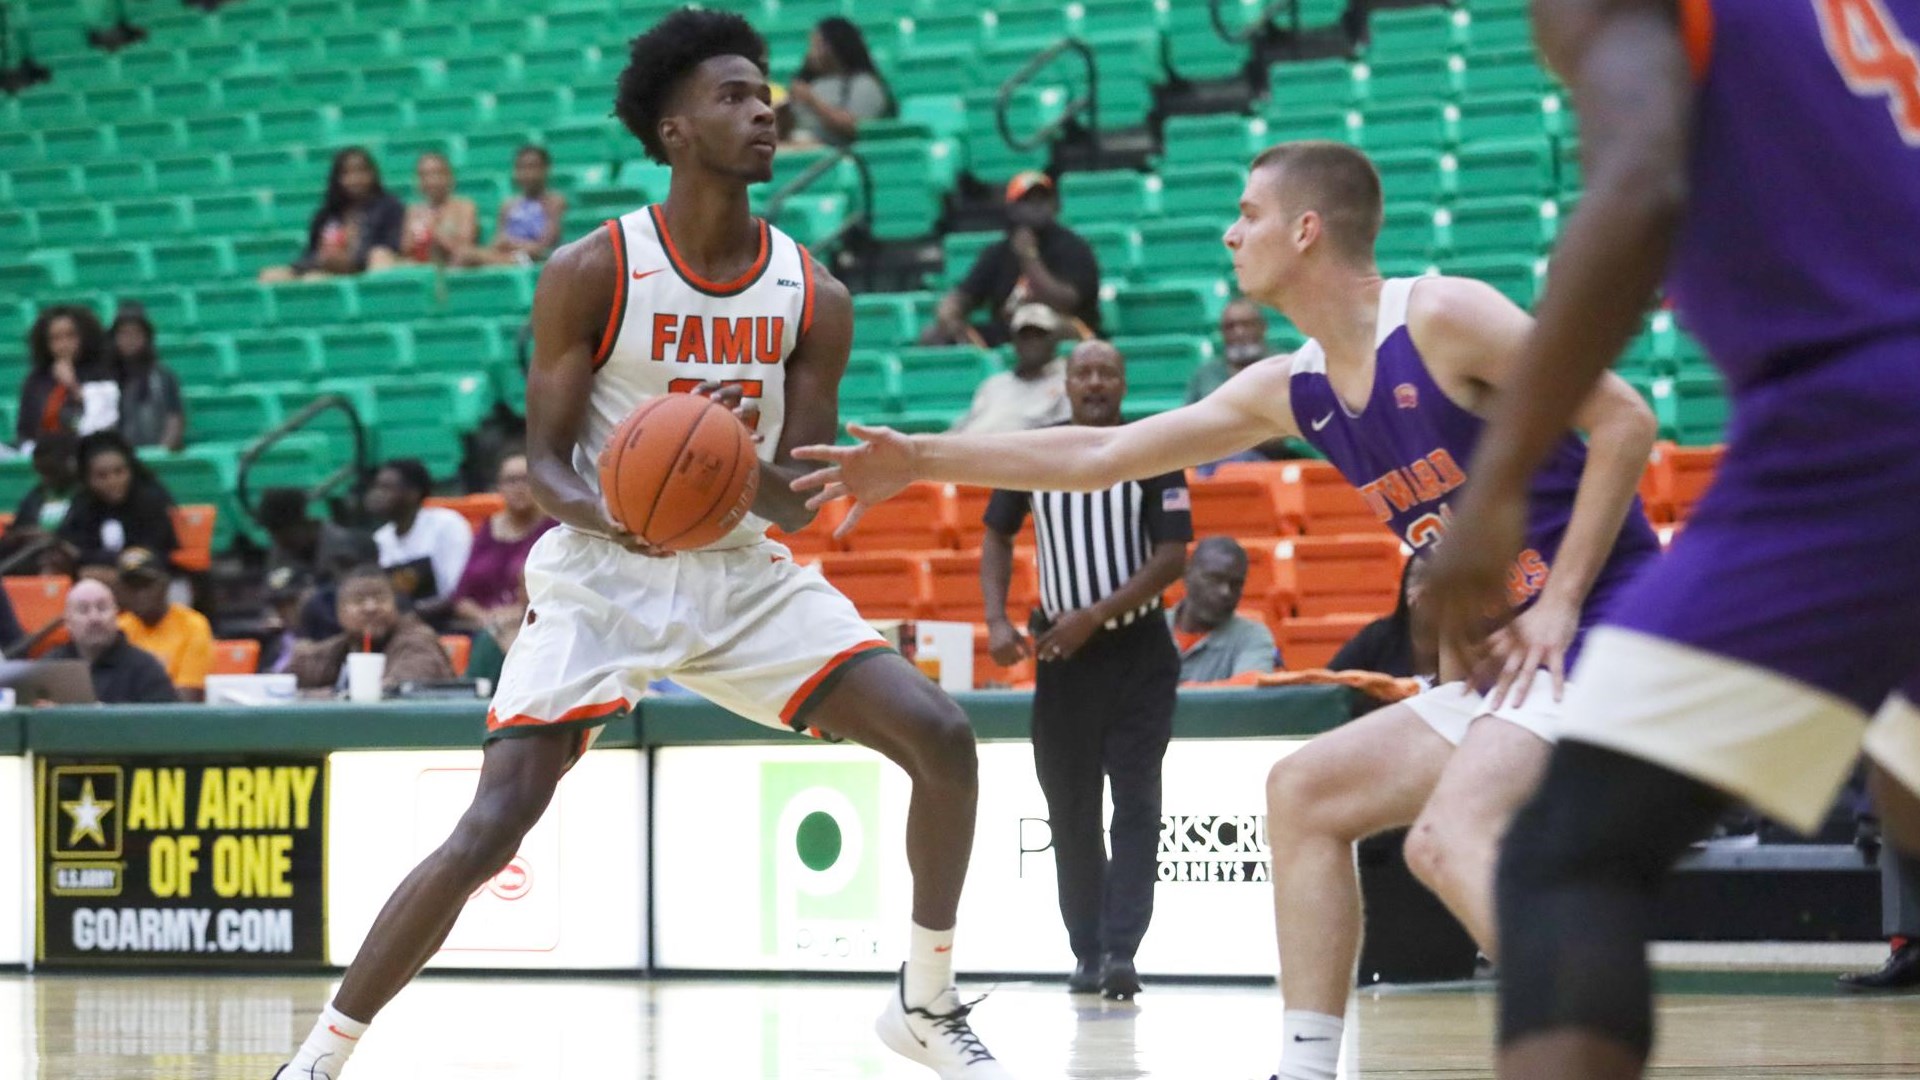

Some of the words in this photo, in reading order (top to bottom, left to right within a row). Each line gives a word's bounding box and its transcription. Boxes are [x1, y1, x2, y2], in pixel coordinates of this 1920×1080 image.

[652, 313, 785, 364] FAMU
[128, 768, 186, 830] AN
[196, 766, 318, 829] ARMY
[150, 835, 200, 897] OF
[212, 835, 294, 897] ONE
[73, 907, 293, 953] GOARMY.COM
